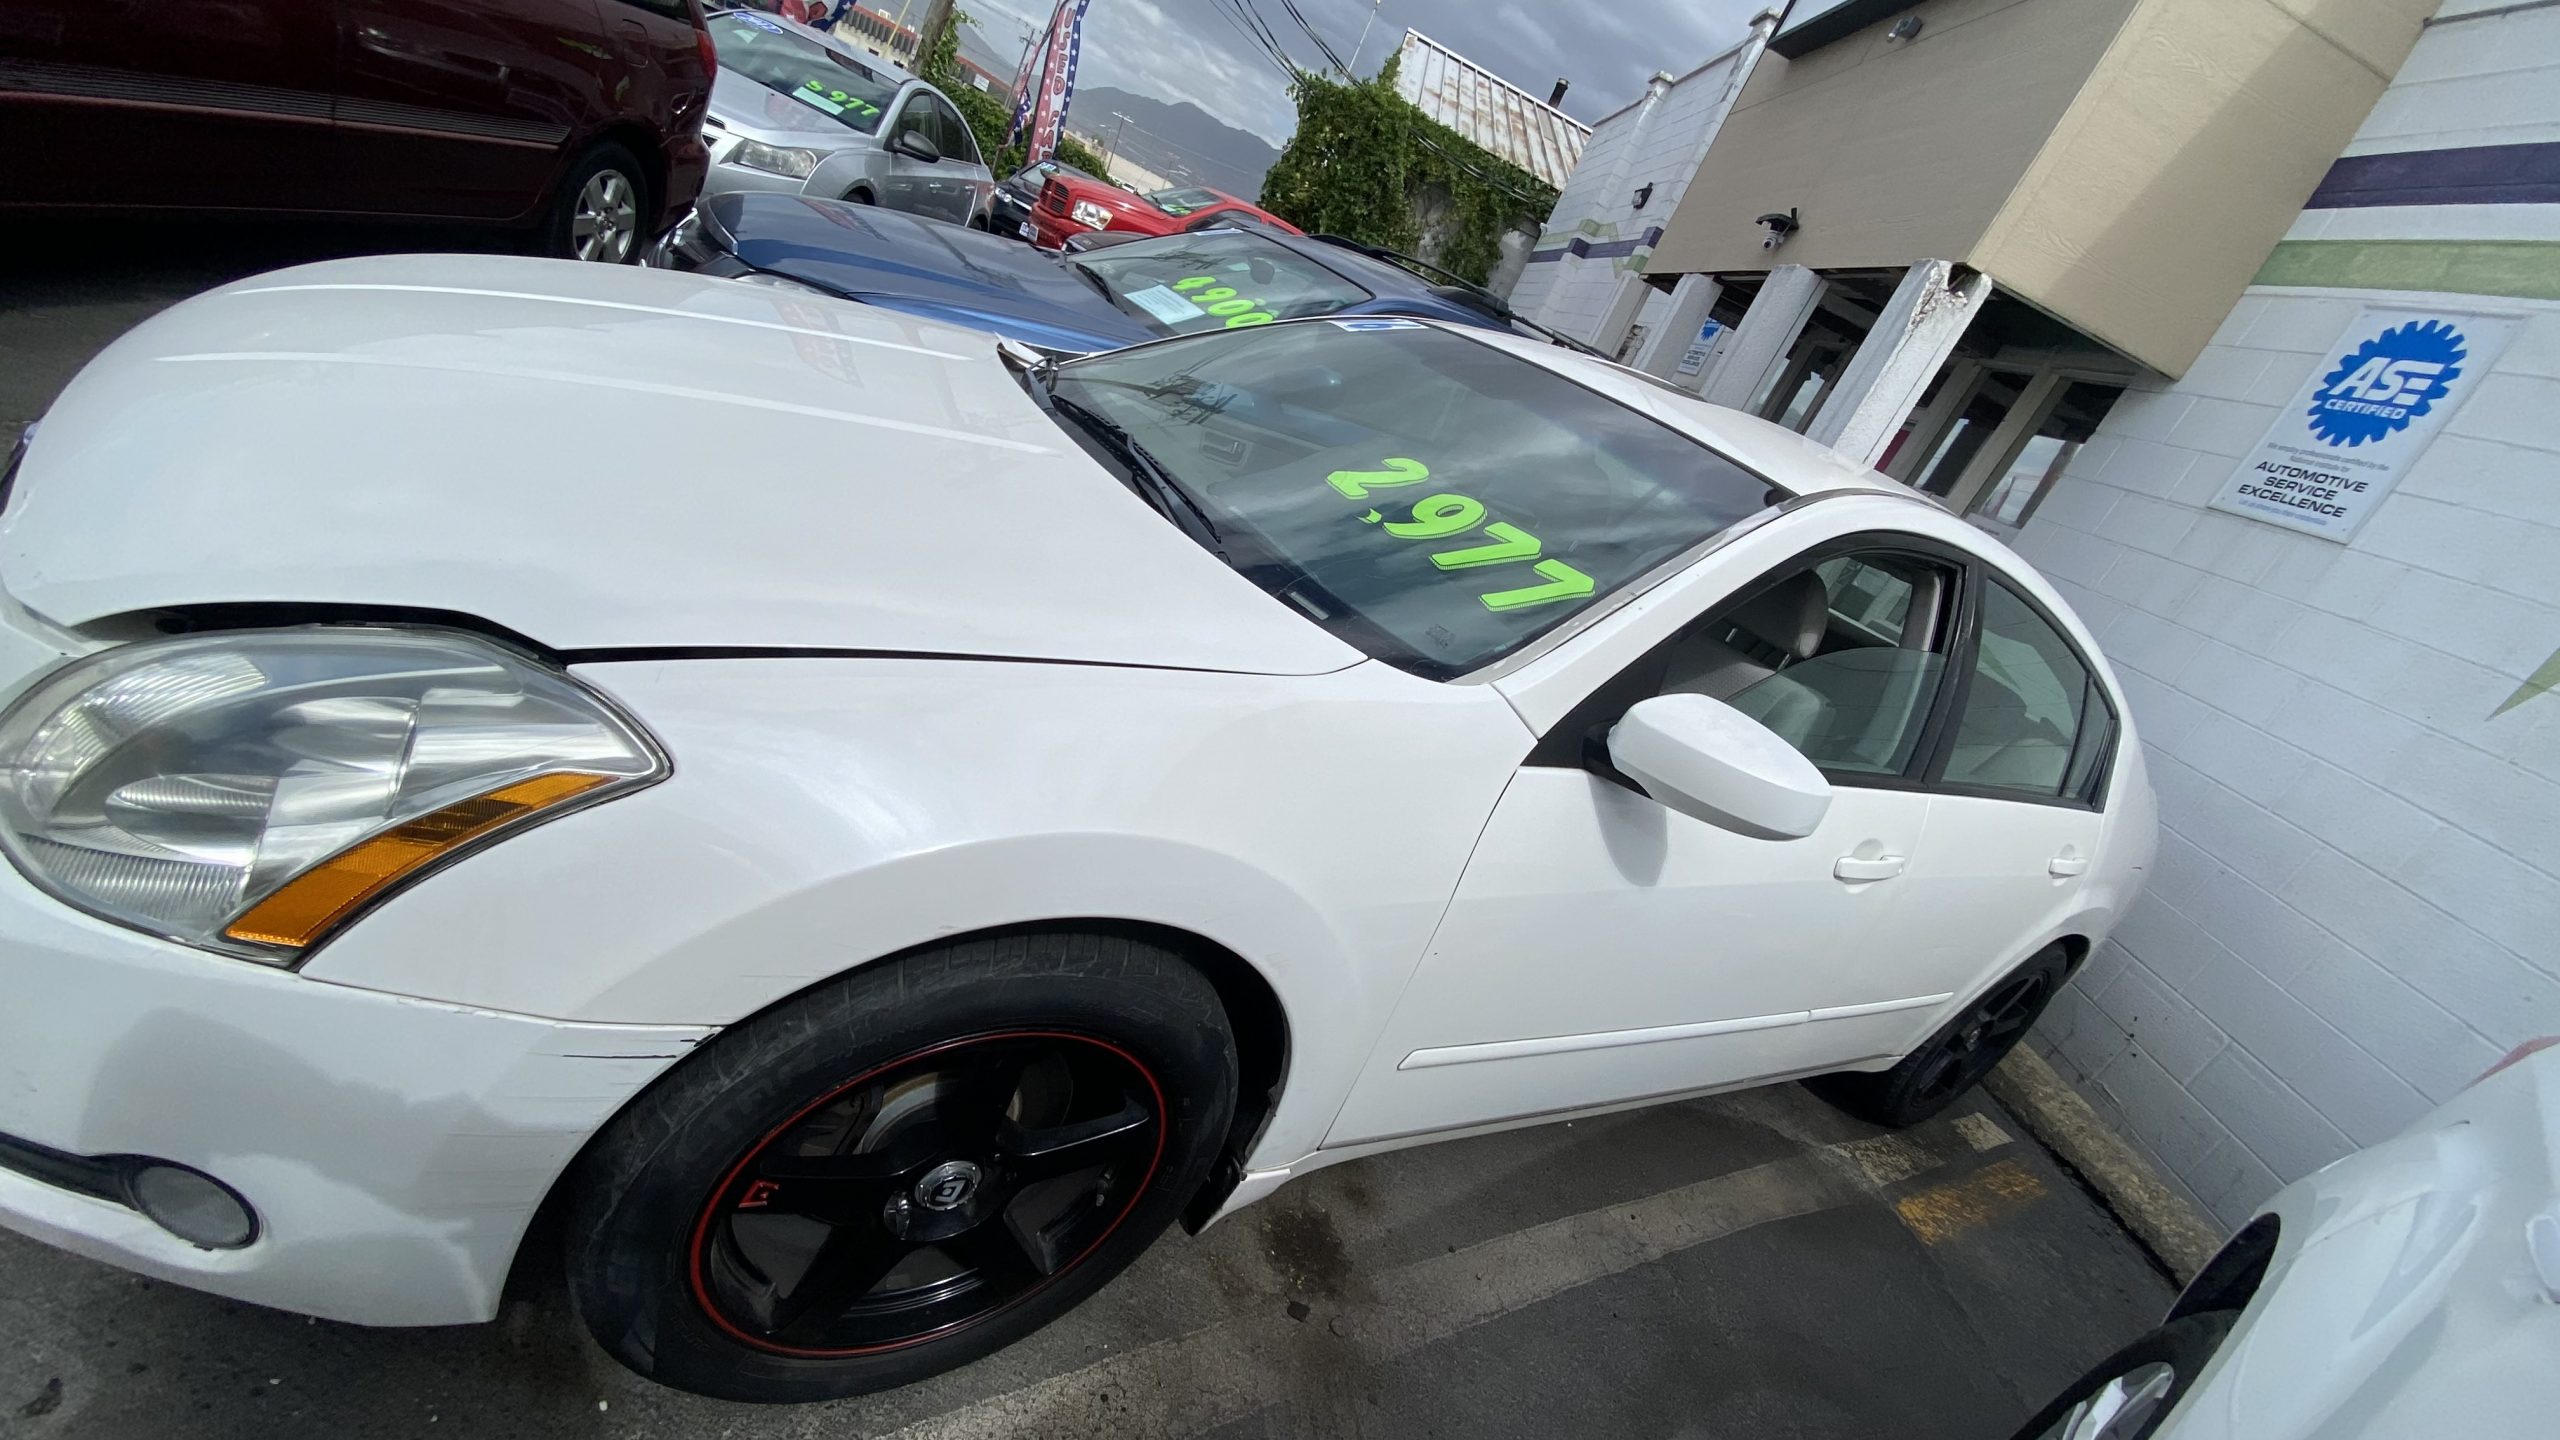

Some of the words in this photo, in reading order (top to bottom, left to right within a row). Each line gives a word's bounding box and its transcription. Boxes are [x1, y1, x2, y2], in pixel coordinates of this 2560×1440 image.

[1053, 8, 1076, 95] USED
[2328, 357, 2444, 406] ASE
[2325, 399, 2407, 420] CERTIFIED
[2256, 461, 2368, 493] AUTOMOTIVE
[2264, 476, 2338, 501] SERVICE
[2238, 484, 2347, 518] EXCELLENCE
[1326, 457, 1595, 612] 2,977
